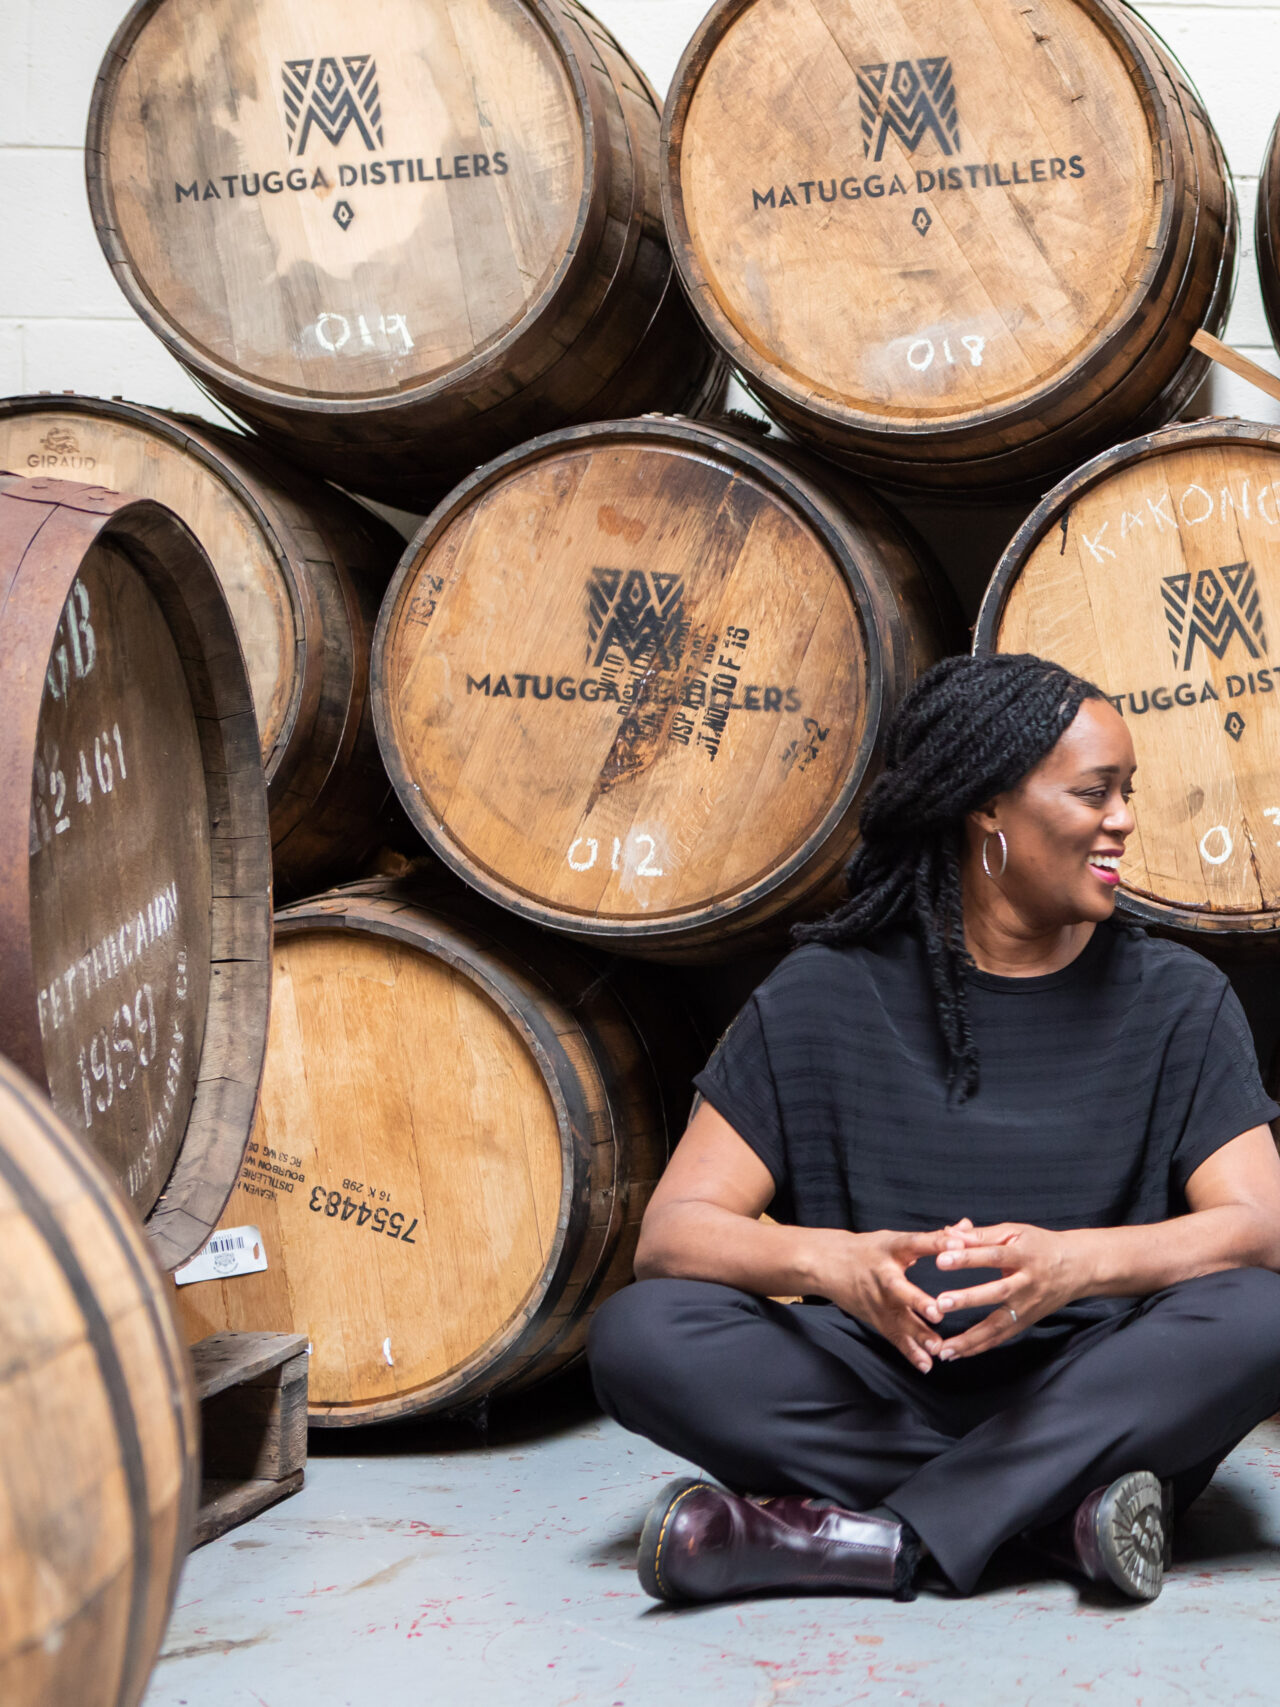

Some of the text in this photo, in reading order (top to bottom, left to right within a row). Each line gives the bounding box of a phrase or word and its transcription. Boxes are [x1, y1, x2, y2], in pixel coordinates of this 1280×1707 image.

[174, 152, 510, 203] MATUGGA DISTILLERS
[751, 155, 1086, 211] MATUGGA DISTILLERS
[27, 453, 96, 472] GIRAUD
[466, 672, 622, 703] MATUGGA
[567, 834, 664, 878] 012
[257, 1160, 305, 1183] BOURBON
[308, 1185, 419, 1244] 7554483
